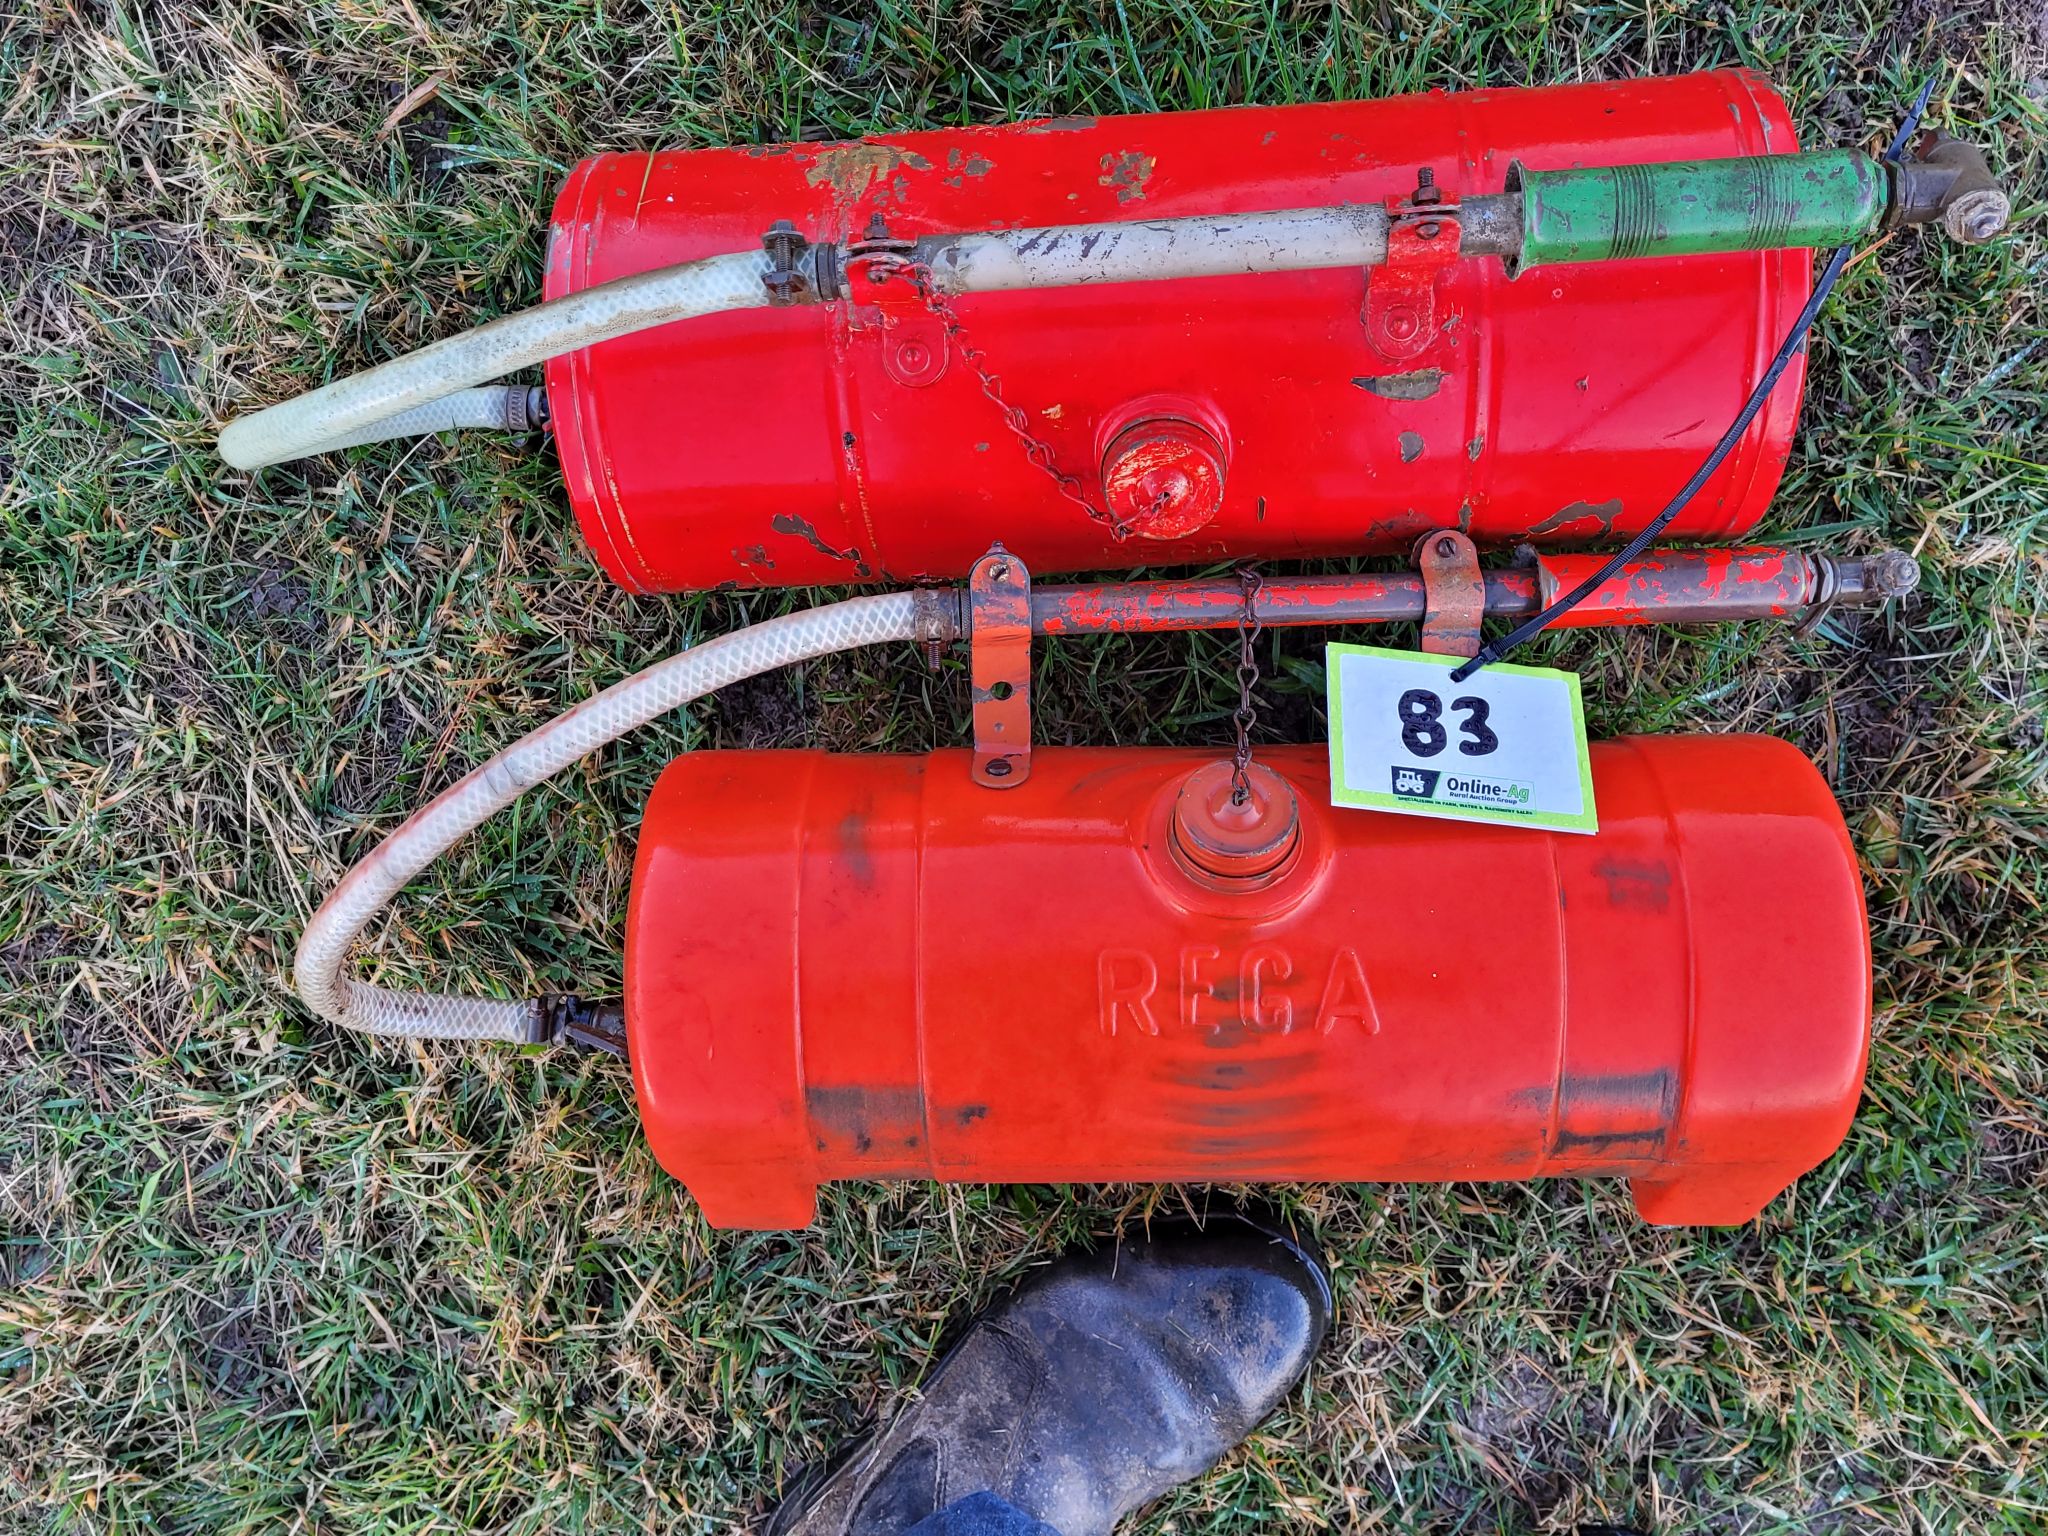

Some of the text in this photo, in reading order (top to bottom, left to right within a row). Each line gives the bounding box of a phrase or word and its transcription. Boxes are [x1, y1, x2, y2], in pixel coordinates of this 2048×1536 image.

[1397, 688, 1499, 758] 83
[1447, 776, 1530, 804] Online-Ag
[1449, 791, 1518, 806] Rural Auction Group
[1098, 944, 1381, 1038] REGA
